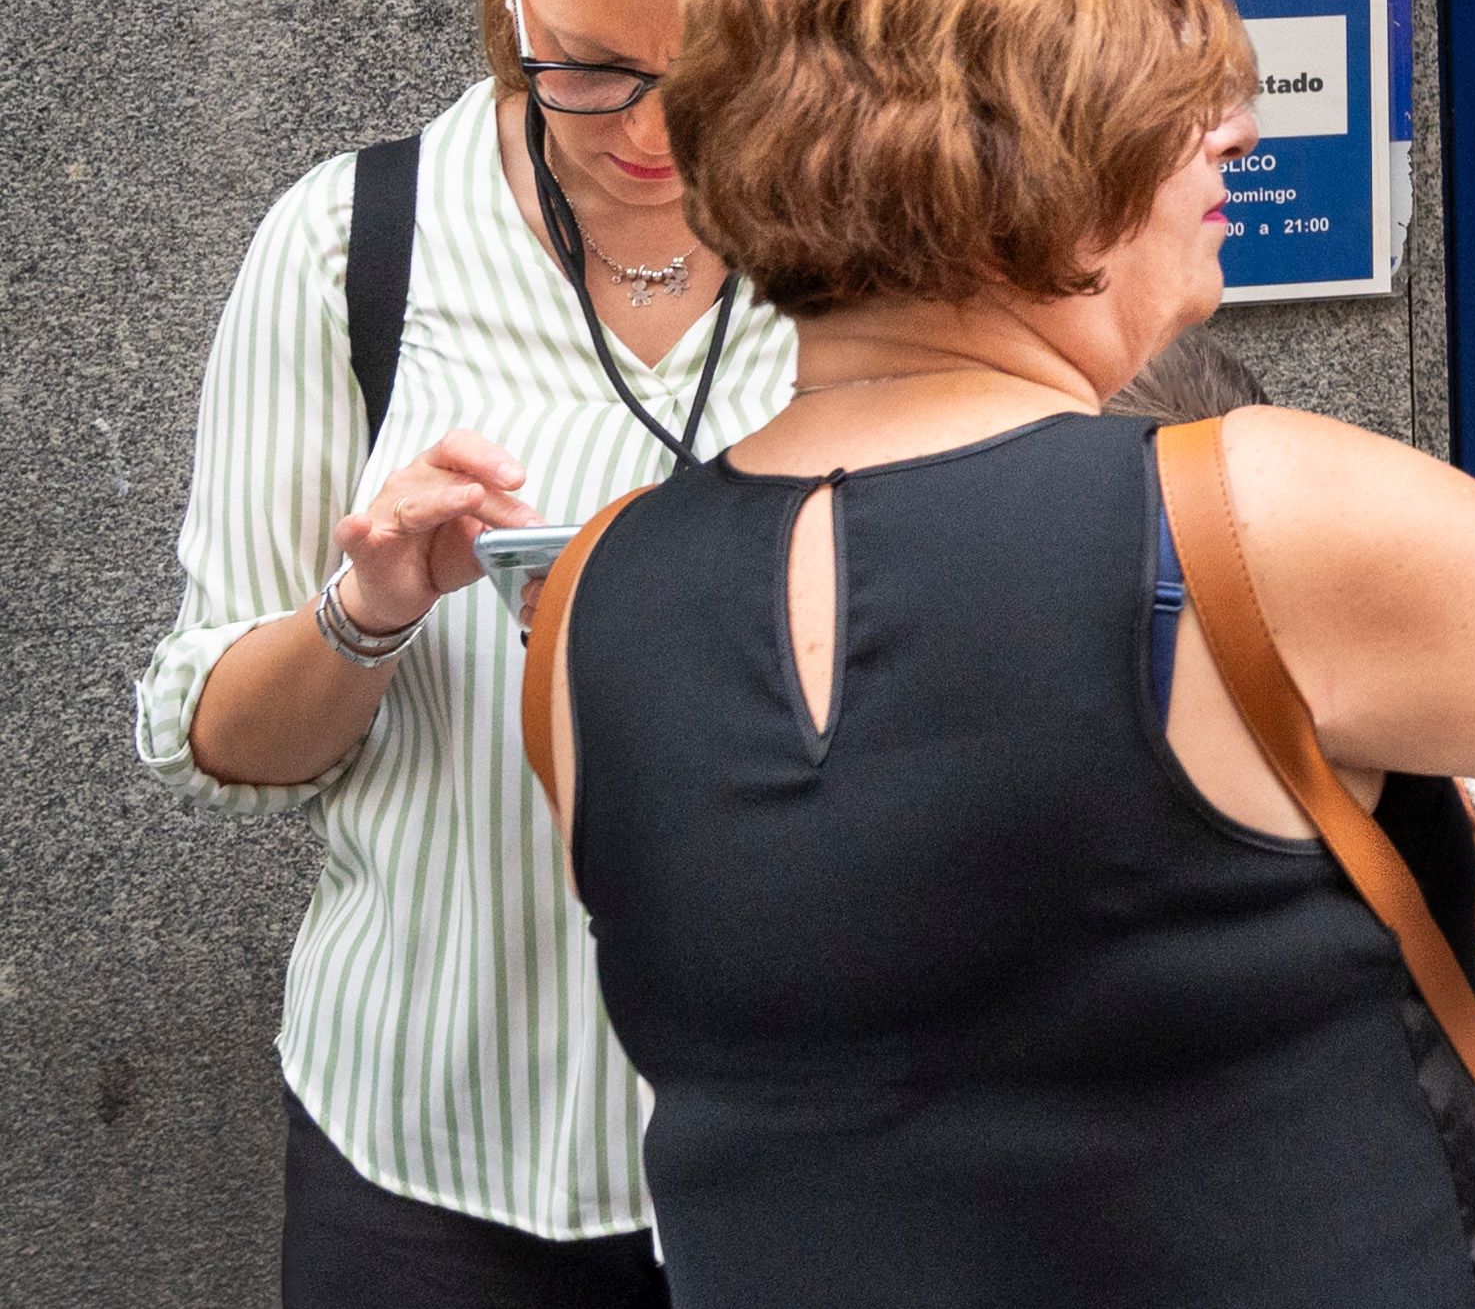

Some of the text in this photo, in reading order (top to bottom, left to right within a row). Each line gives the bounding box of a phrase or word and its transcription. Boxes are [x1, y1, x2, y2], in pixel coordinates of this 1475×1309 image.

[1258, 71, 1324, 96] stado
[1259, 224, 1270, 236] a
[1284, 218, 1330, 234] 21:00
